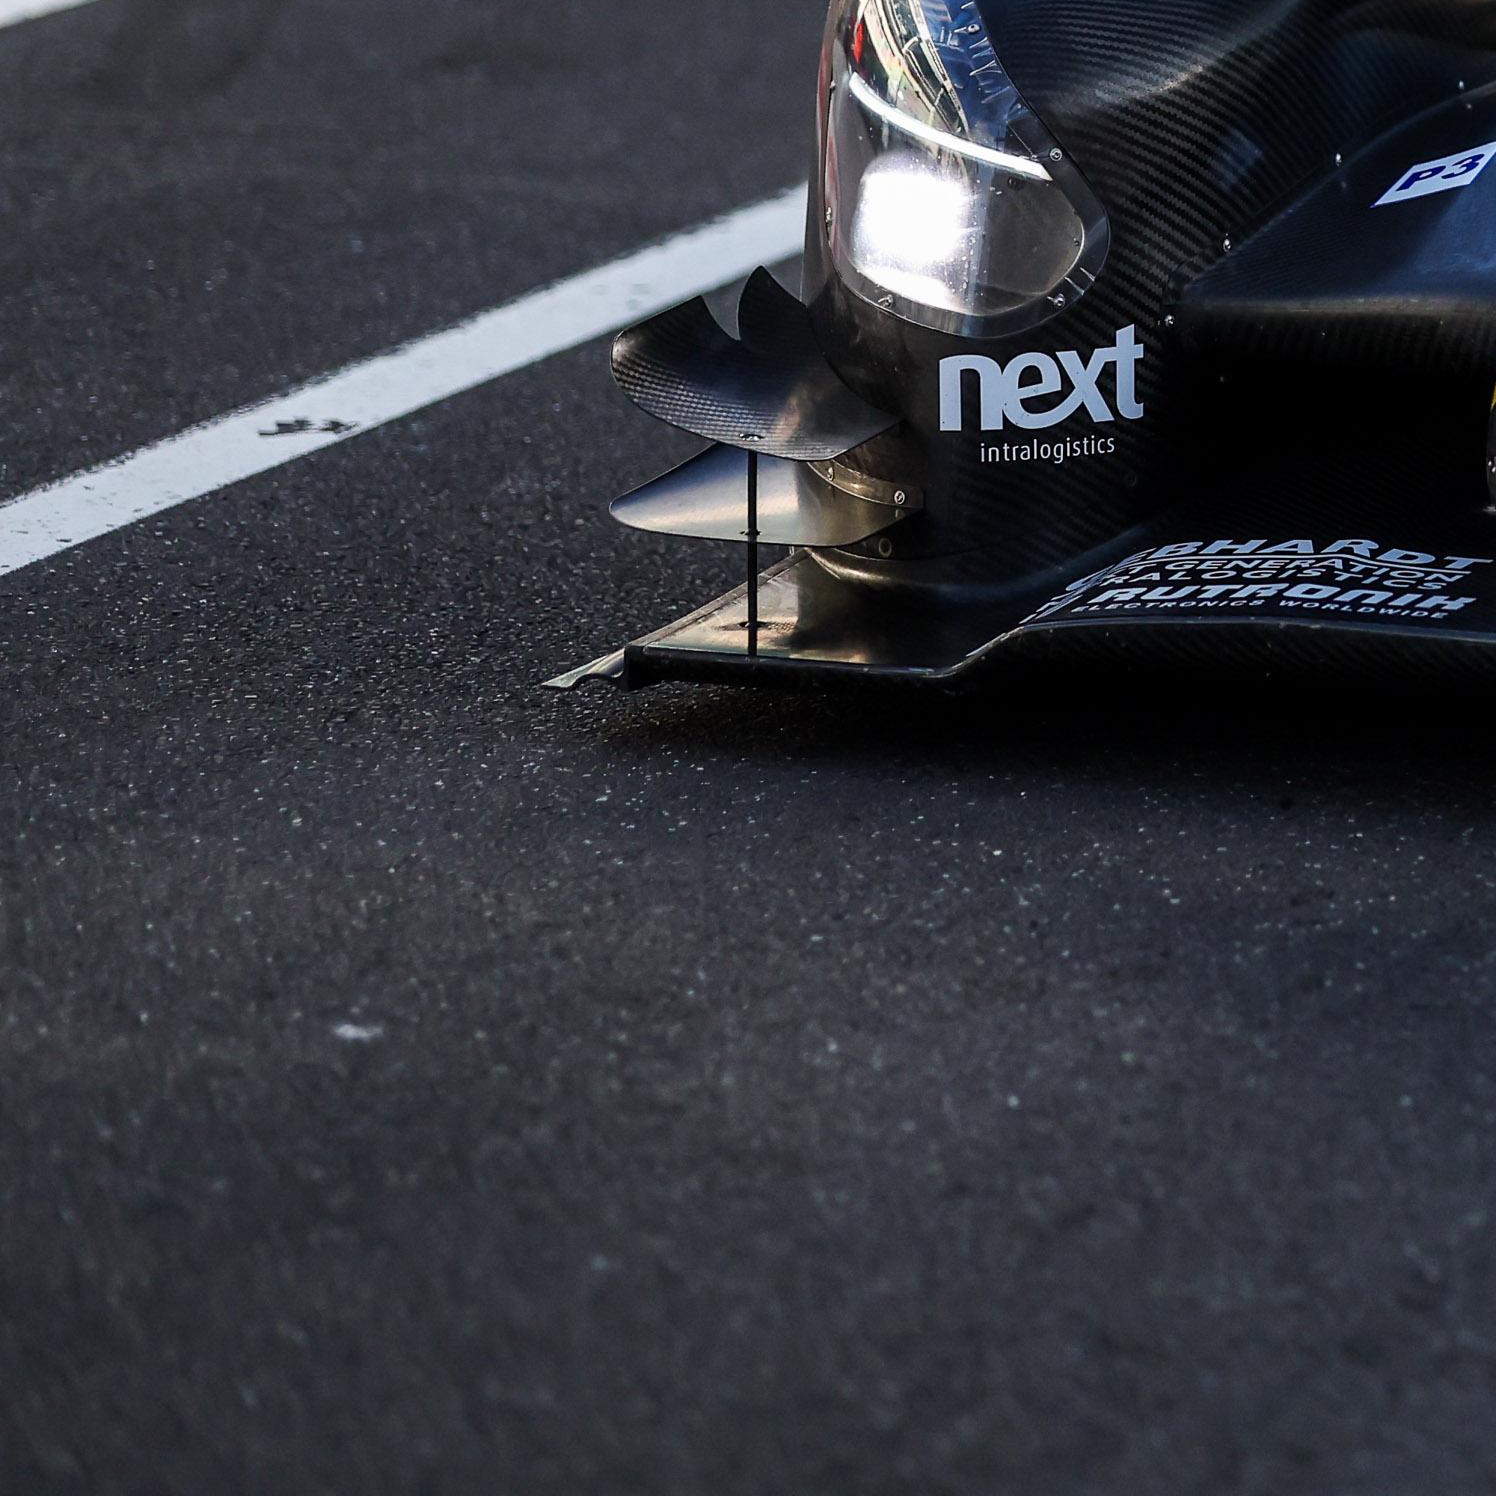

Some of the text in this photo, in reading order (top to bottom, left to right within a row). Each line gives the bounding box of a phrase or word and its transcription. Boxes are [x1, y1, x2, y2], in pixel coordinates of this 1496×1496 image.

[1395, 153, 1485, 192] P3
[938, 323, 1144, 432] next
[980, 434, 1115, 464] intralogistics
[1164, 558, 1467, 583] GENERATION
[1086, 583, 1477, 611] RUTRONIK
[1279, 599, 1449, 619] WORLDWIDE
